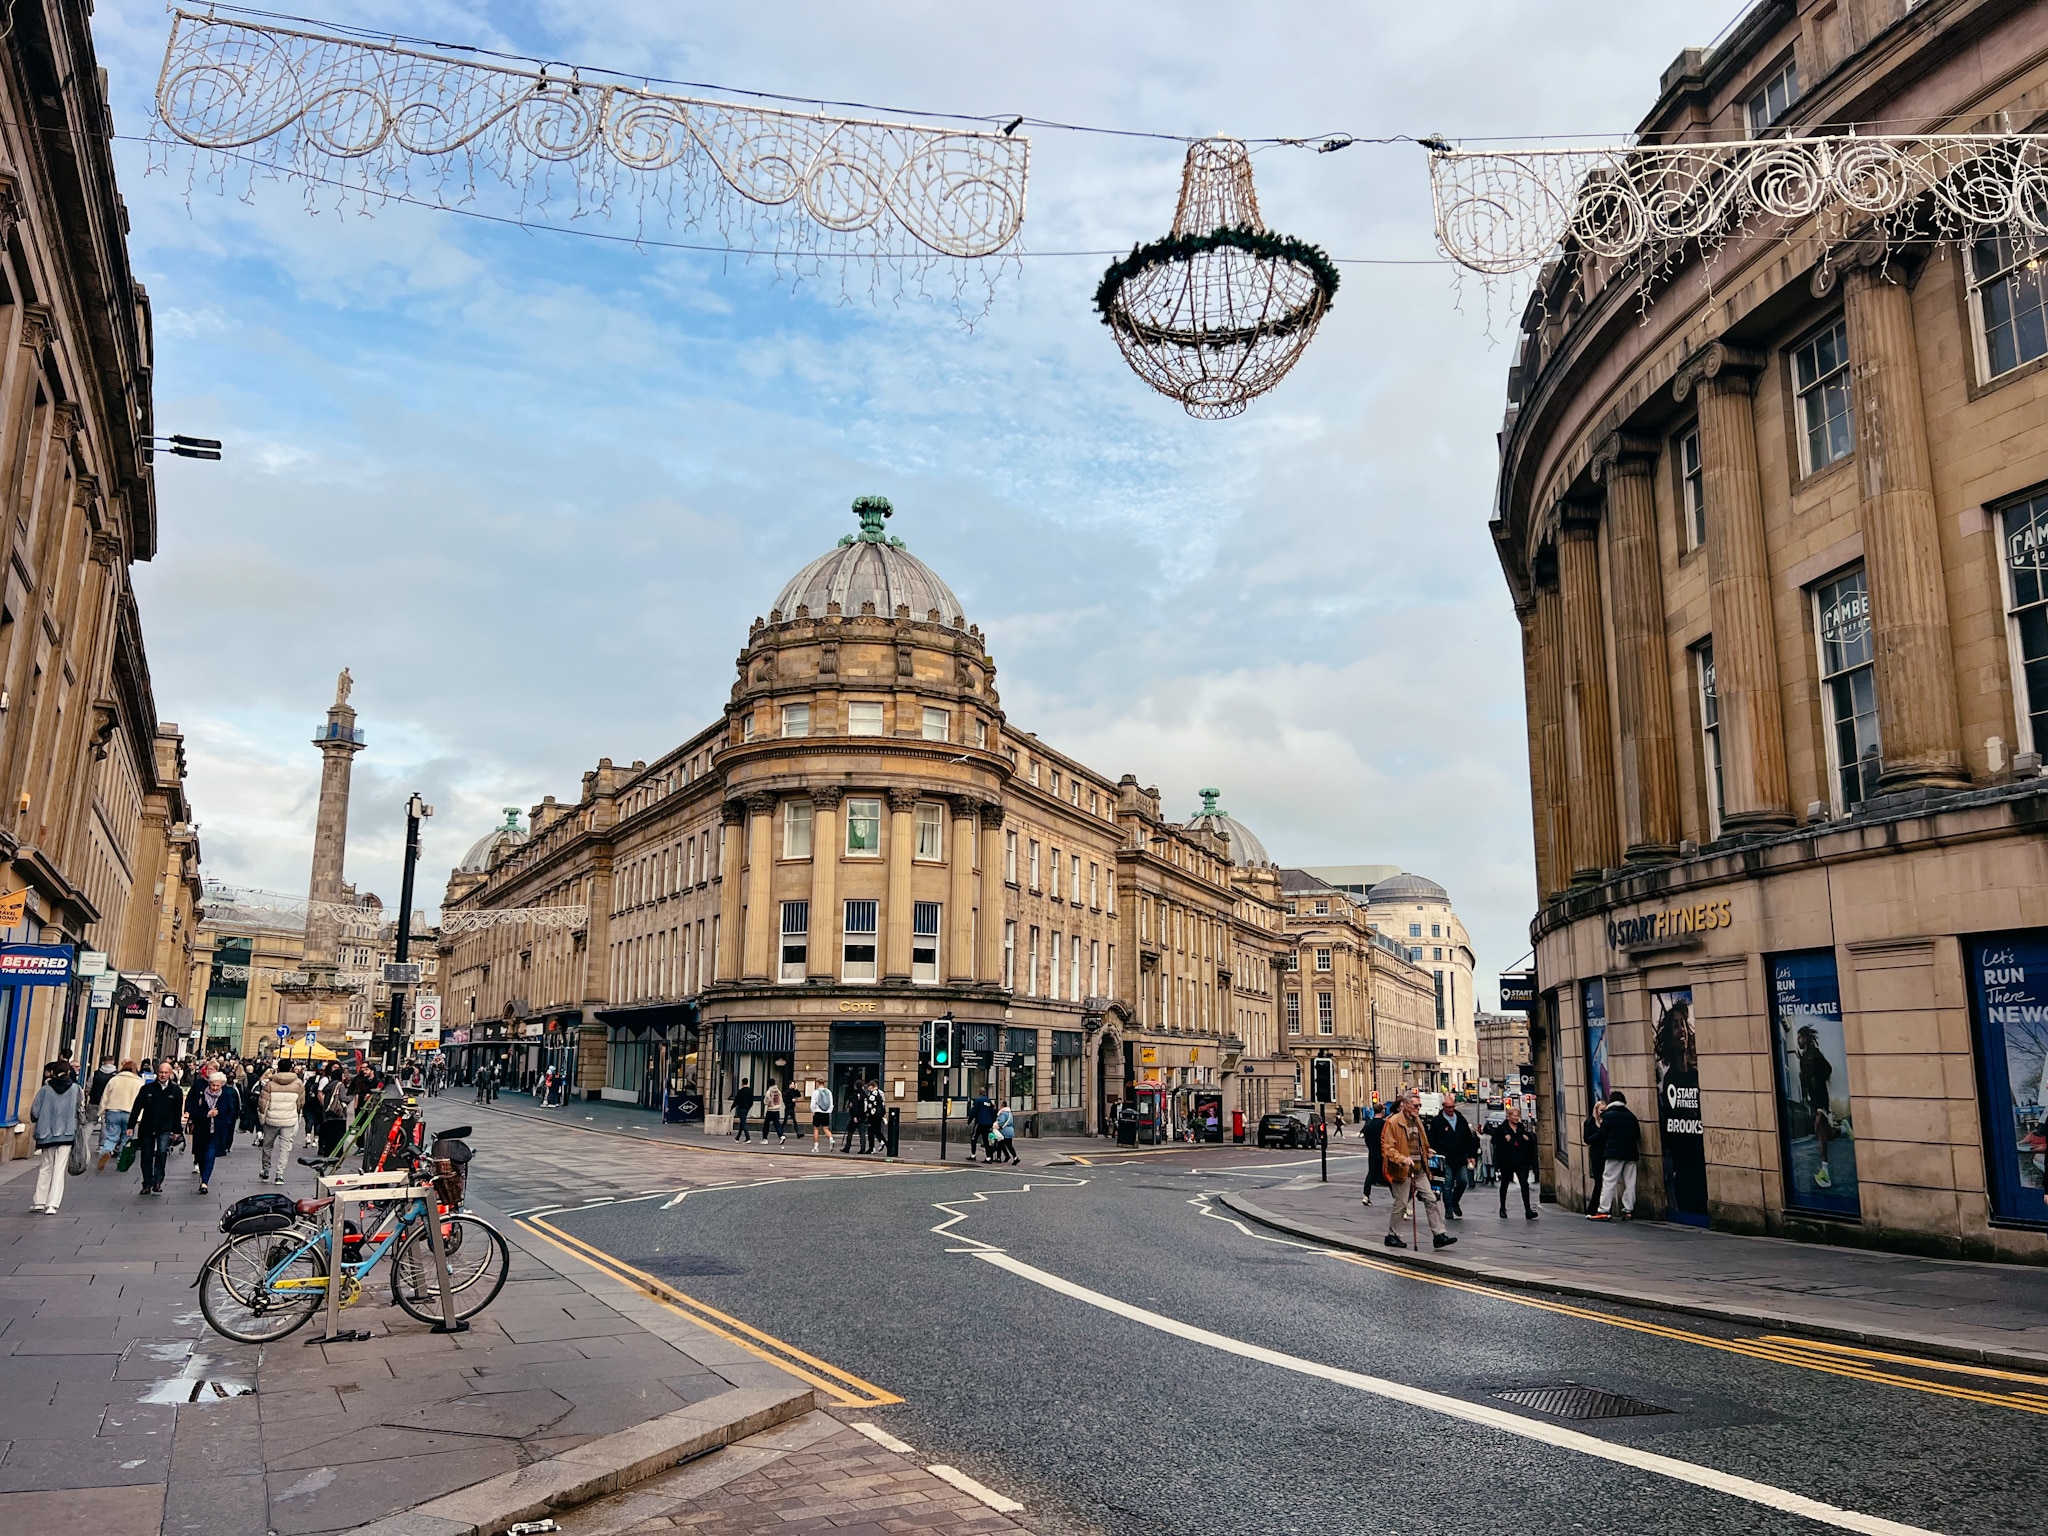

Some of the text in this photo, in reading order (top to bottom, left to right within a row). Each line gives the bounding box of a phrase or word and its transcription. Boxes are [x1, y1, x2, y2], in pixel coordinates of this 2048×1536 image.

[2, 957, 68, 968] BETFRED
[1983, 947, 2014, 967] Let's
[1984, 967, 2024, 985] RUN
[1776, 980, 1796, 991] RUN
[1777, 992, 1800, 1003] There
[1986, 986, 2036, 1004] There
[1778, 1002, 1838, 1015] NEWCASTLE
[212, 1016, 237, 1024] REISS
[1677, 1087, 1699, 1099] START
[1676, 1099, 1698, 1108] FITNESS
[1667, 1118, 1703, 1134] BROOKS
